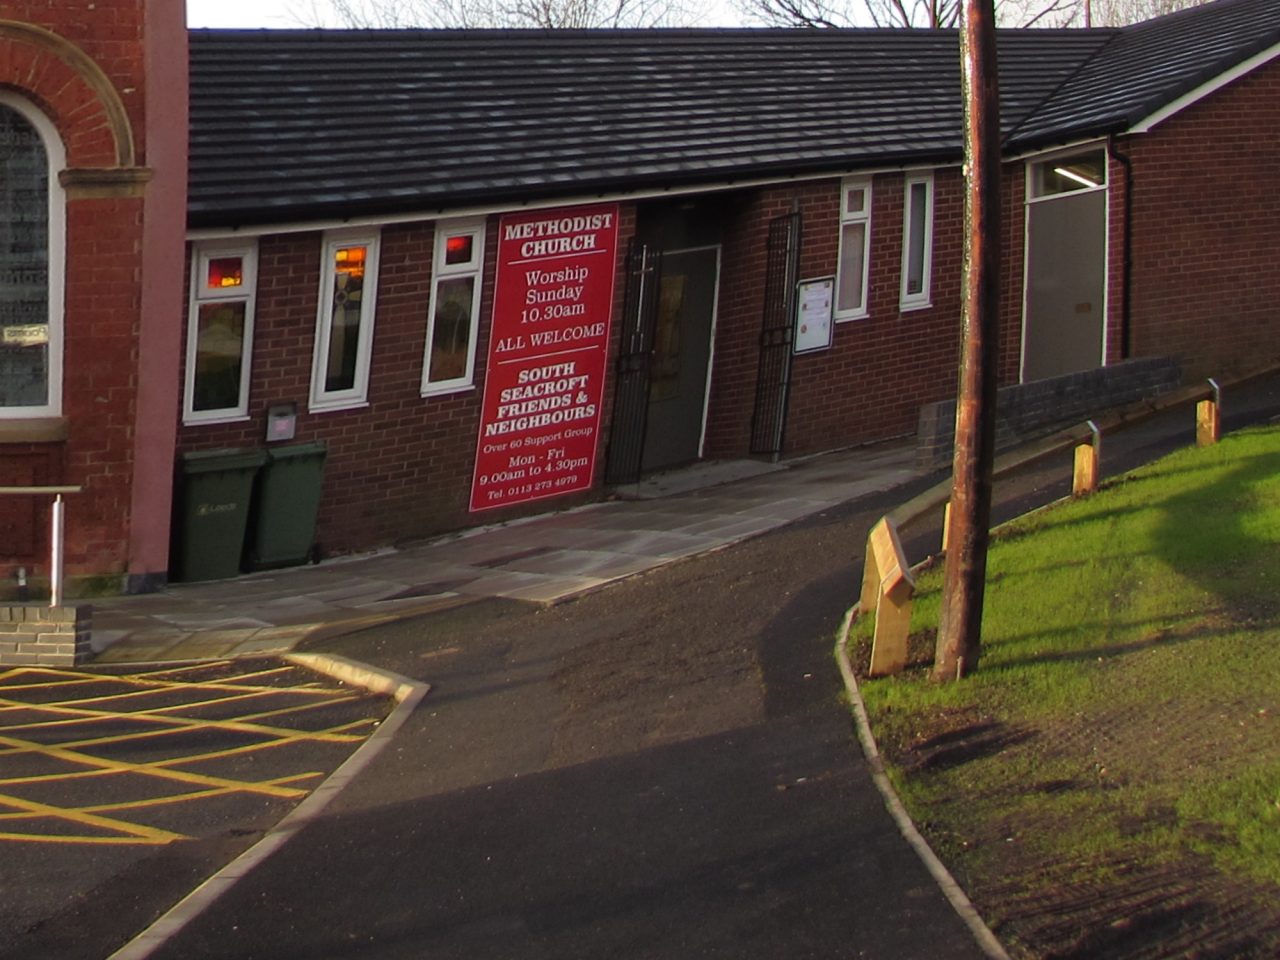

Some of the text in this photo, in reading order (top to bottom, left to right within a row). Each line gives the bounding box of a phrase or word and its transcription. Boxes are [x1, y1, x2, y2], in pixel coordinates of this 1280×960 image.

[504, 213, 613, 241] METHODIST
[521, 234, 596, 258] CHURCH
[525, 265, 589, 286] Worship
[526, 285, 584, 305] Sunday
[521, 303, 585, 324] 10.30am
[495, 322, 605, 353] ALL WELCOME
[518, 361, 576, 384] SOUTH
[500, 375, 589, 403] SEACROFT
[496, 390, 588, 419] FRIENDS &
[485, 404, 596, 437] NEIGHBOURS
[483, 427, 593, 454] Over 60 Support Group
[509, 455, 535, 468] Mon
[547, 446, 565, 460] Fri
[480, 456, 588, 486] 9.00am to 4.30pm
[508, 484, 532, 496] 0113
[535, 480, 552, 491] 273
